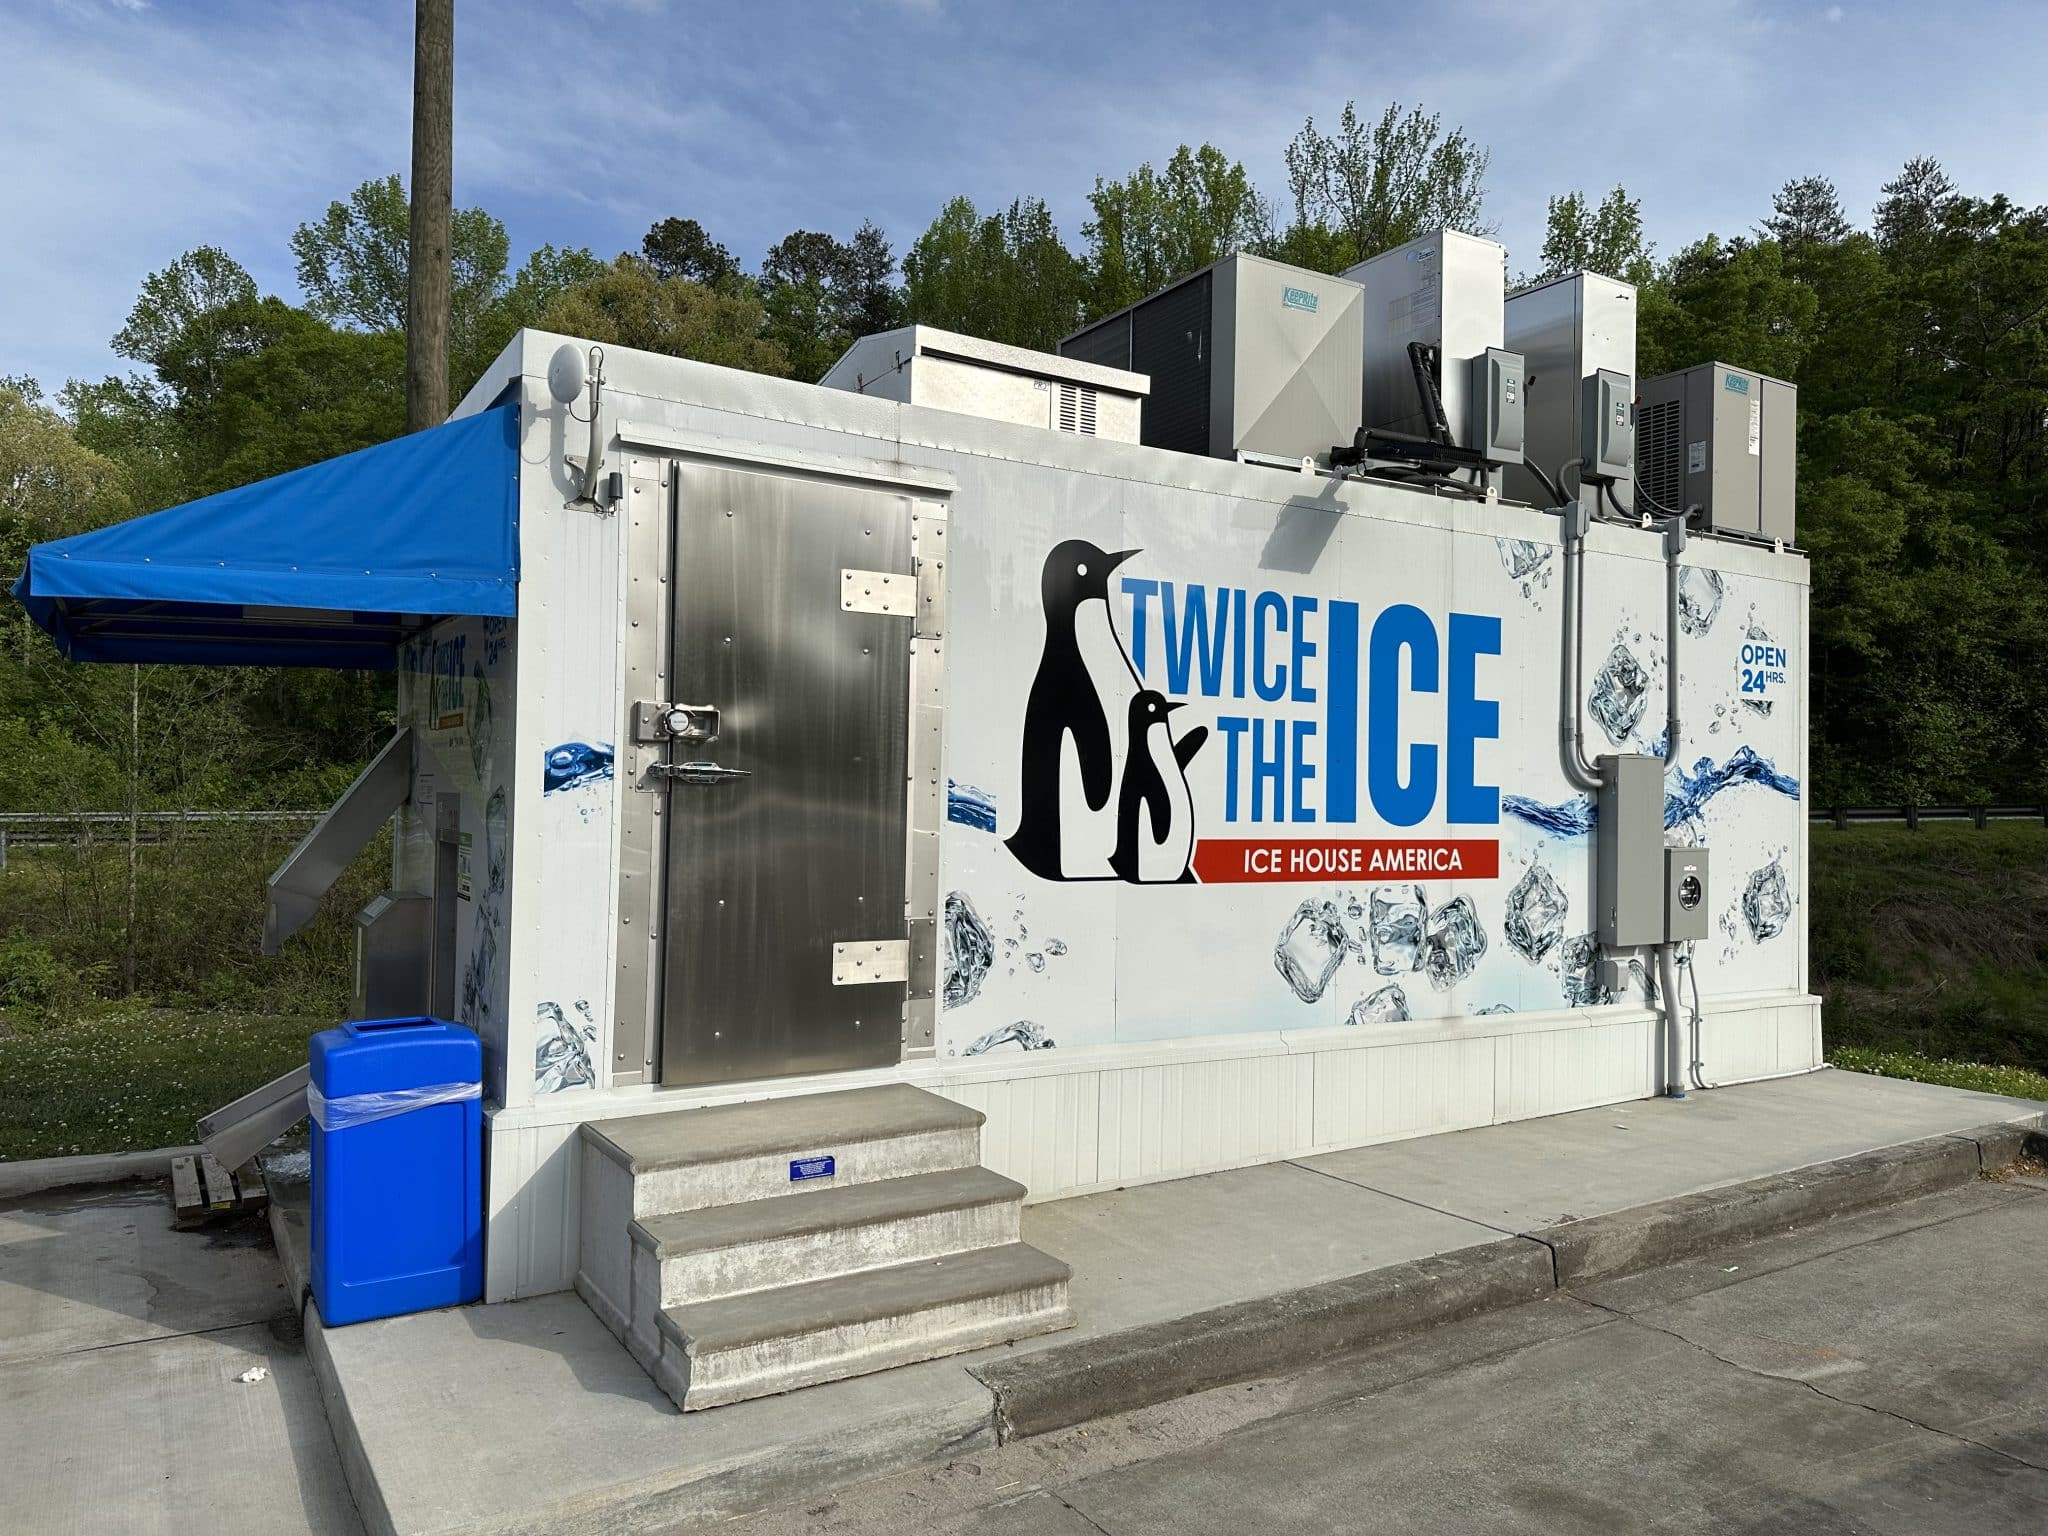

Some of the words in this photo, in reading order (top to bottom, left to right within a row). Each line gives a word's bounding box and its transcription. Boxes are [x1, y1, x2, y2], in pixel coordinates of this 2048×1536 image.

[1121, 577, 1317, 703] TWICE
[1741, 644, 1786, 668] OPEN
[1325, 599, 1502, 827] ICE
[1741, 668, 1766, 693] 24
[1766, 671, 1786, 684] HRS.
[1217, 716, 1317, 823] THE
[1244, 848, 1282, 873] ICE
[1290, 848, 1362, 873] HOUSE
[1368, 847, 1463, 872] AMERICA
